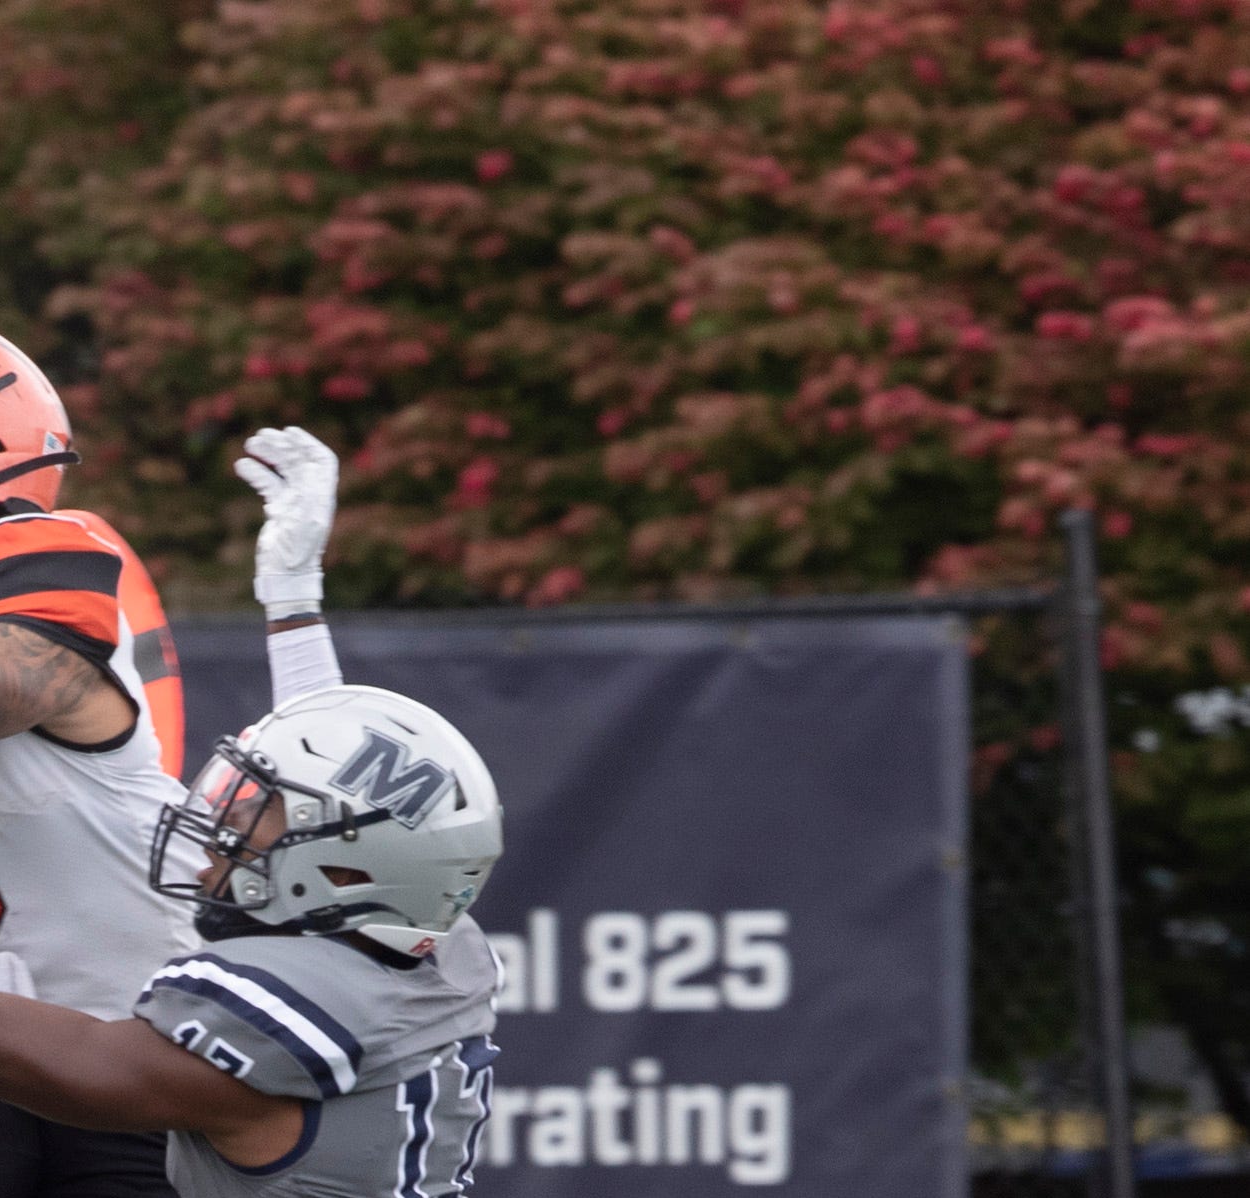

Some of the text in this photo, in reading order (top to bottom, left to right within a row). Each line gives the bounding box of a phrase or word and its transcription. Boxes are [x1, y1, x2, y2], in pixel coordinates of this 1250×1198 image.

[328, 725, 455, 829] M
[586, 911, 791, 1013] 825
[478, 1057, 791, 1185] rating
